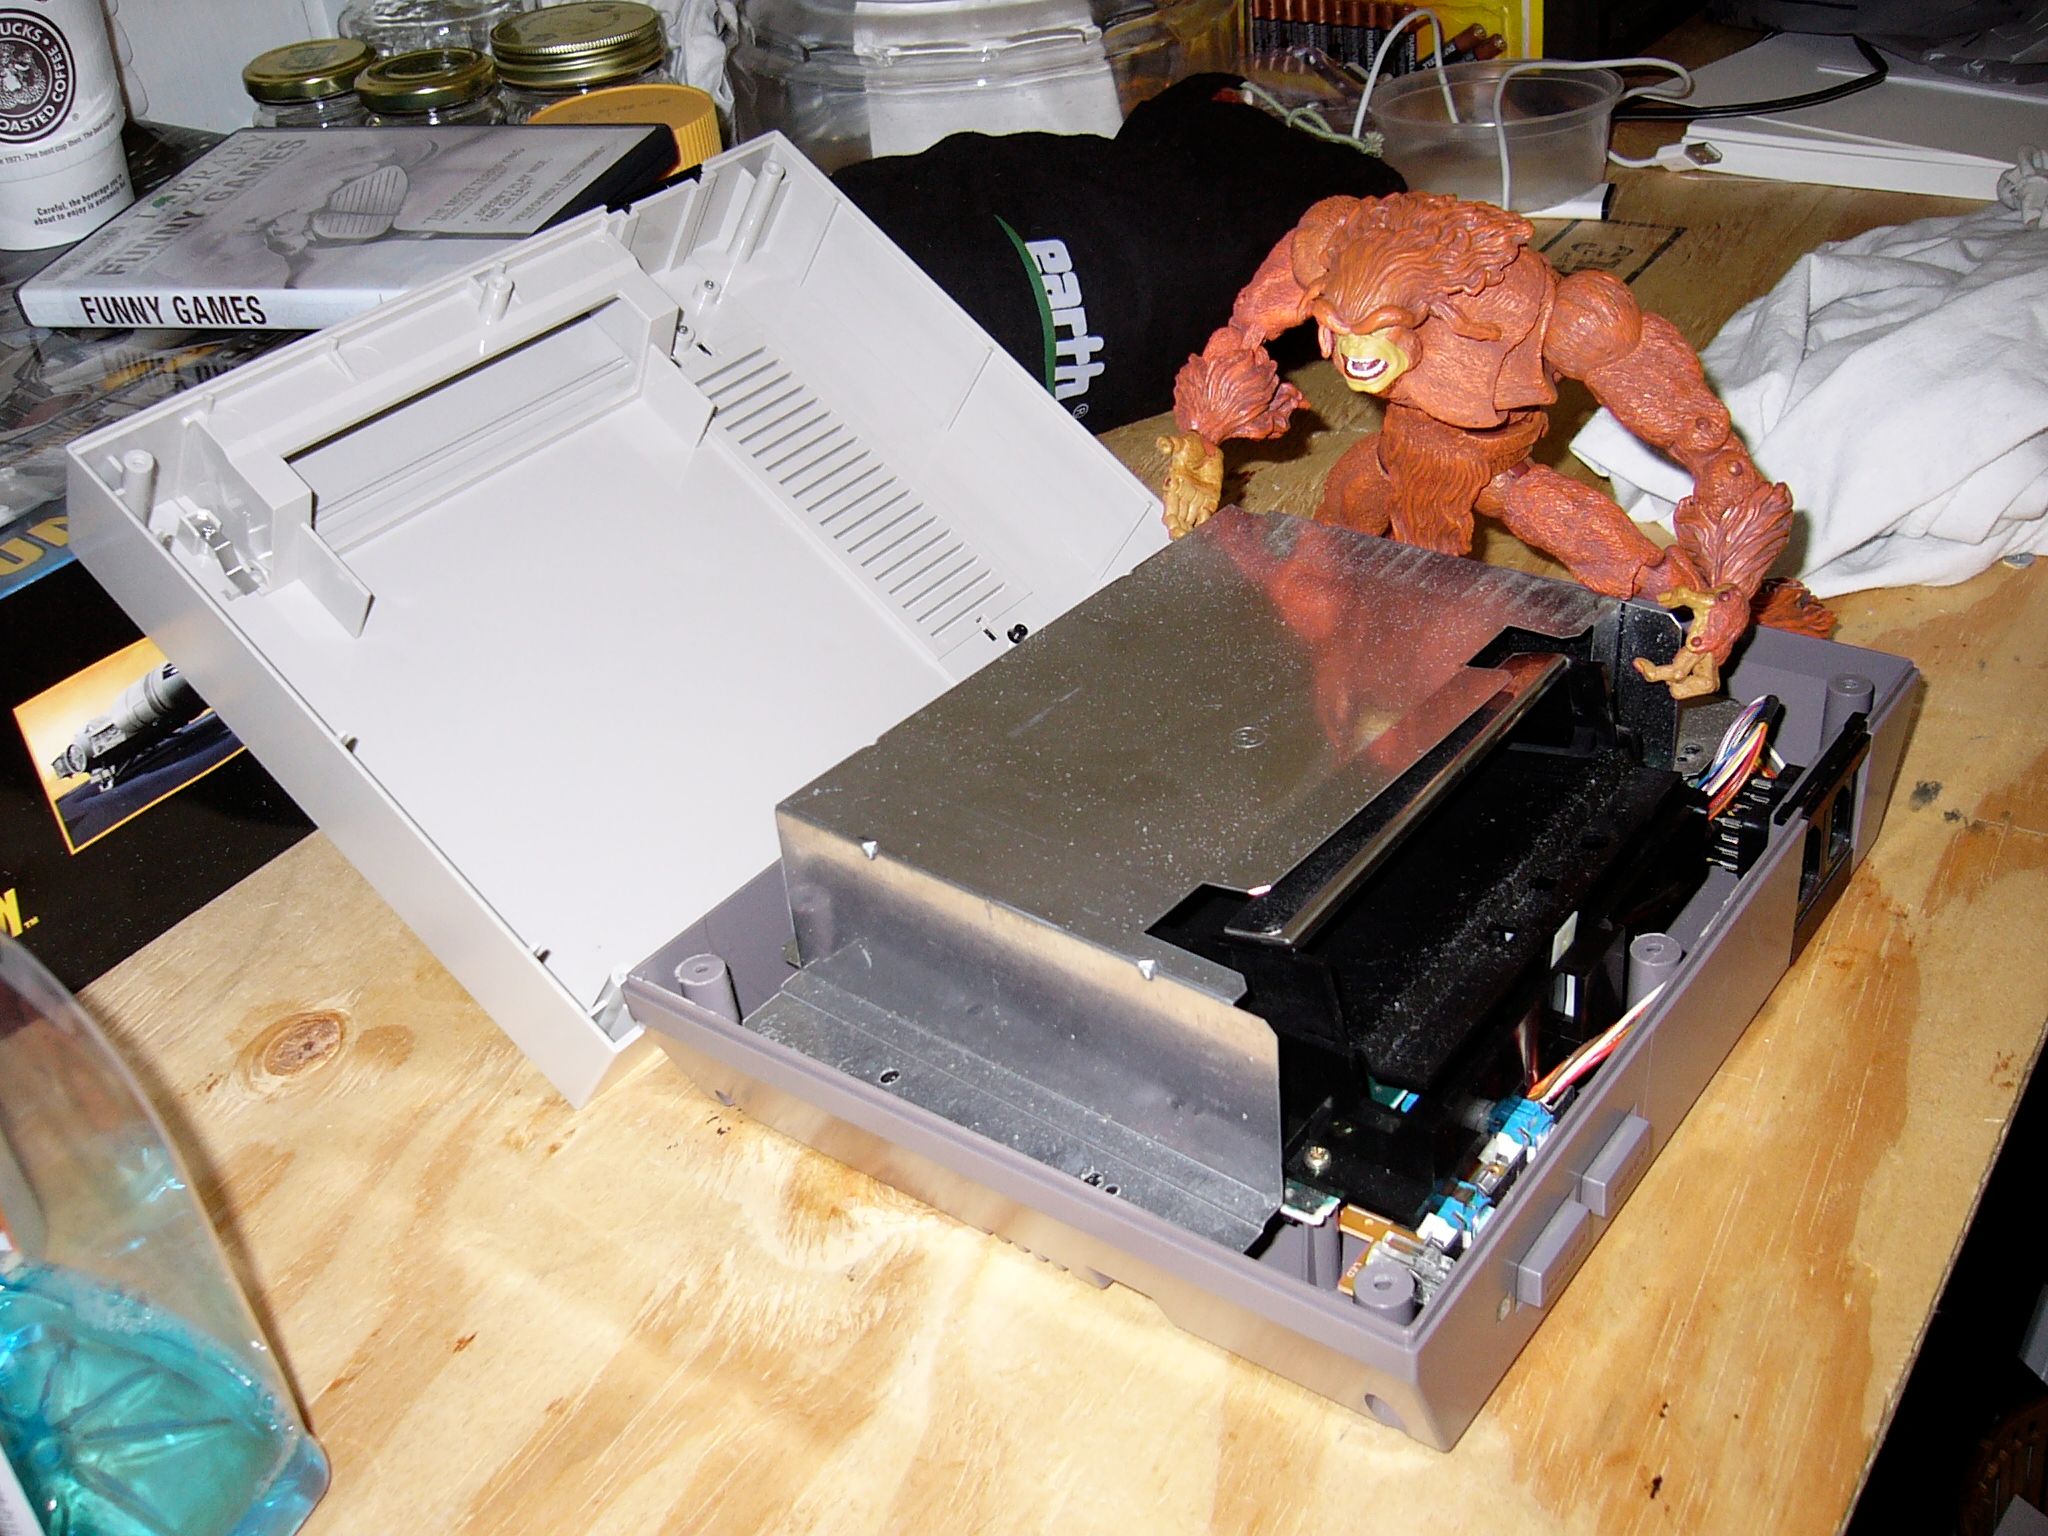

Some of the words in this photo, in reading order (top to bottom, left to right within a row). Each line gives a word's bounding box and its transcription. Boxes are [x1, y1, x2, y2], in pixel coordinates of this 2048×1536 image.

[47, 44, 67, 103] COFFEE
[204, 138, 306, 204] GAMES
[80, 296, 166, 325] FUNNY
[172, 295, 268, 325] GAMES
[1025, 239, 1105, 402] earth
